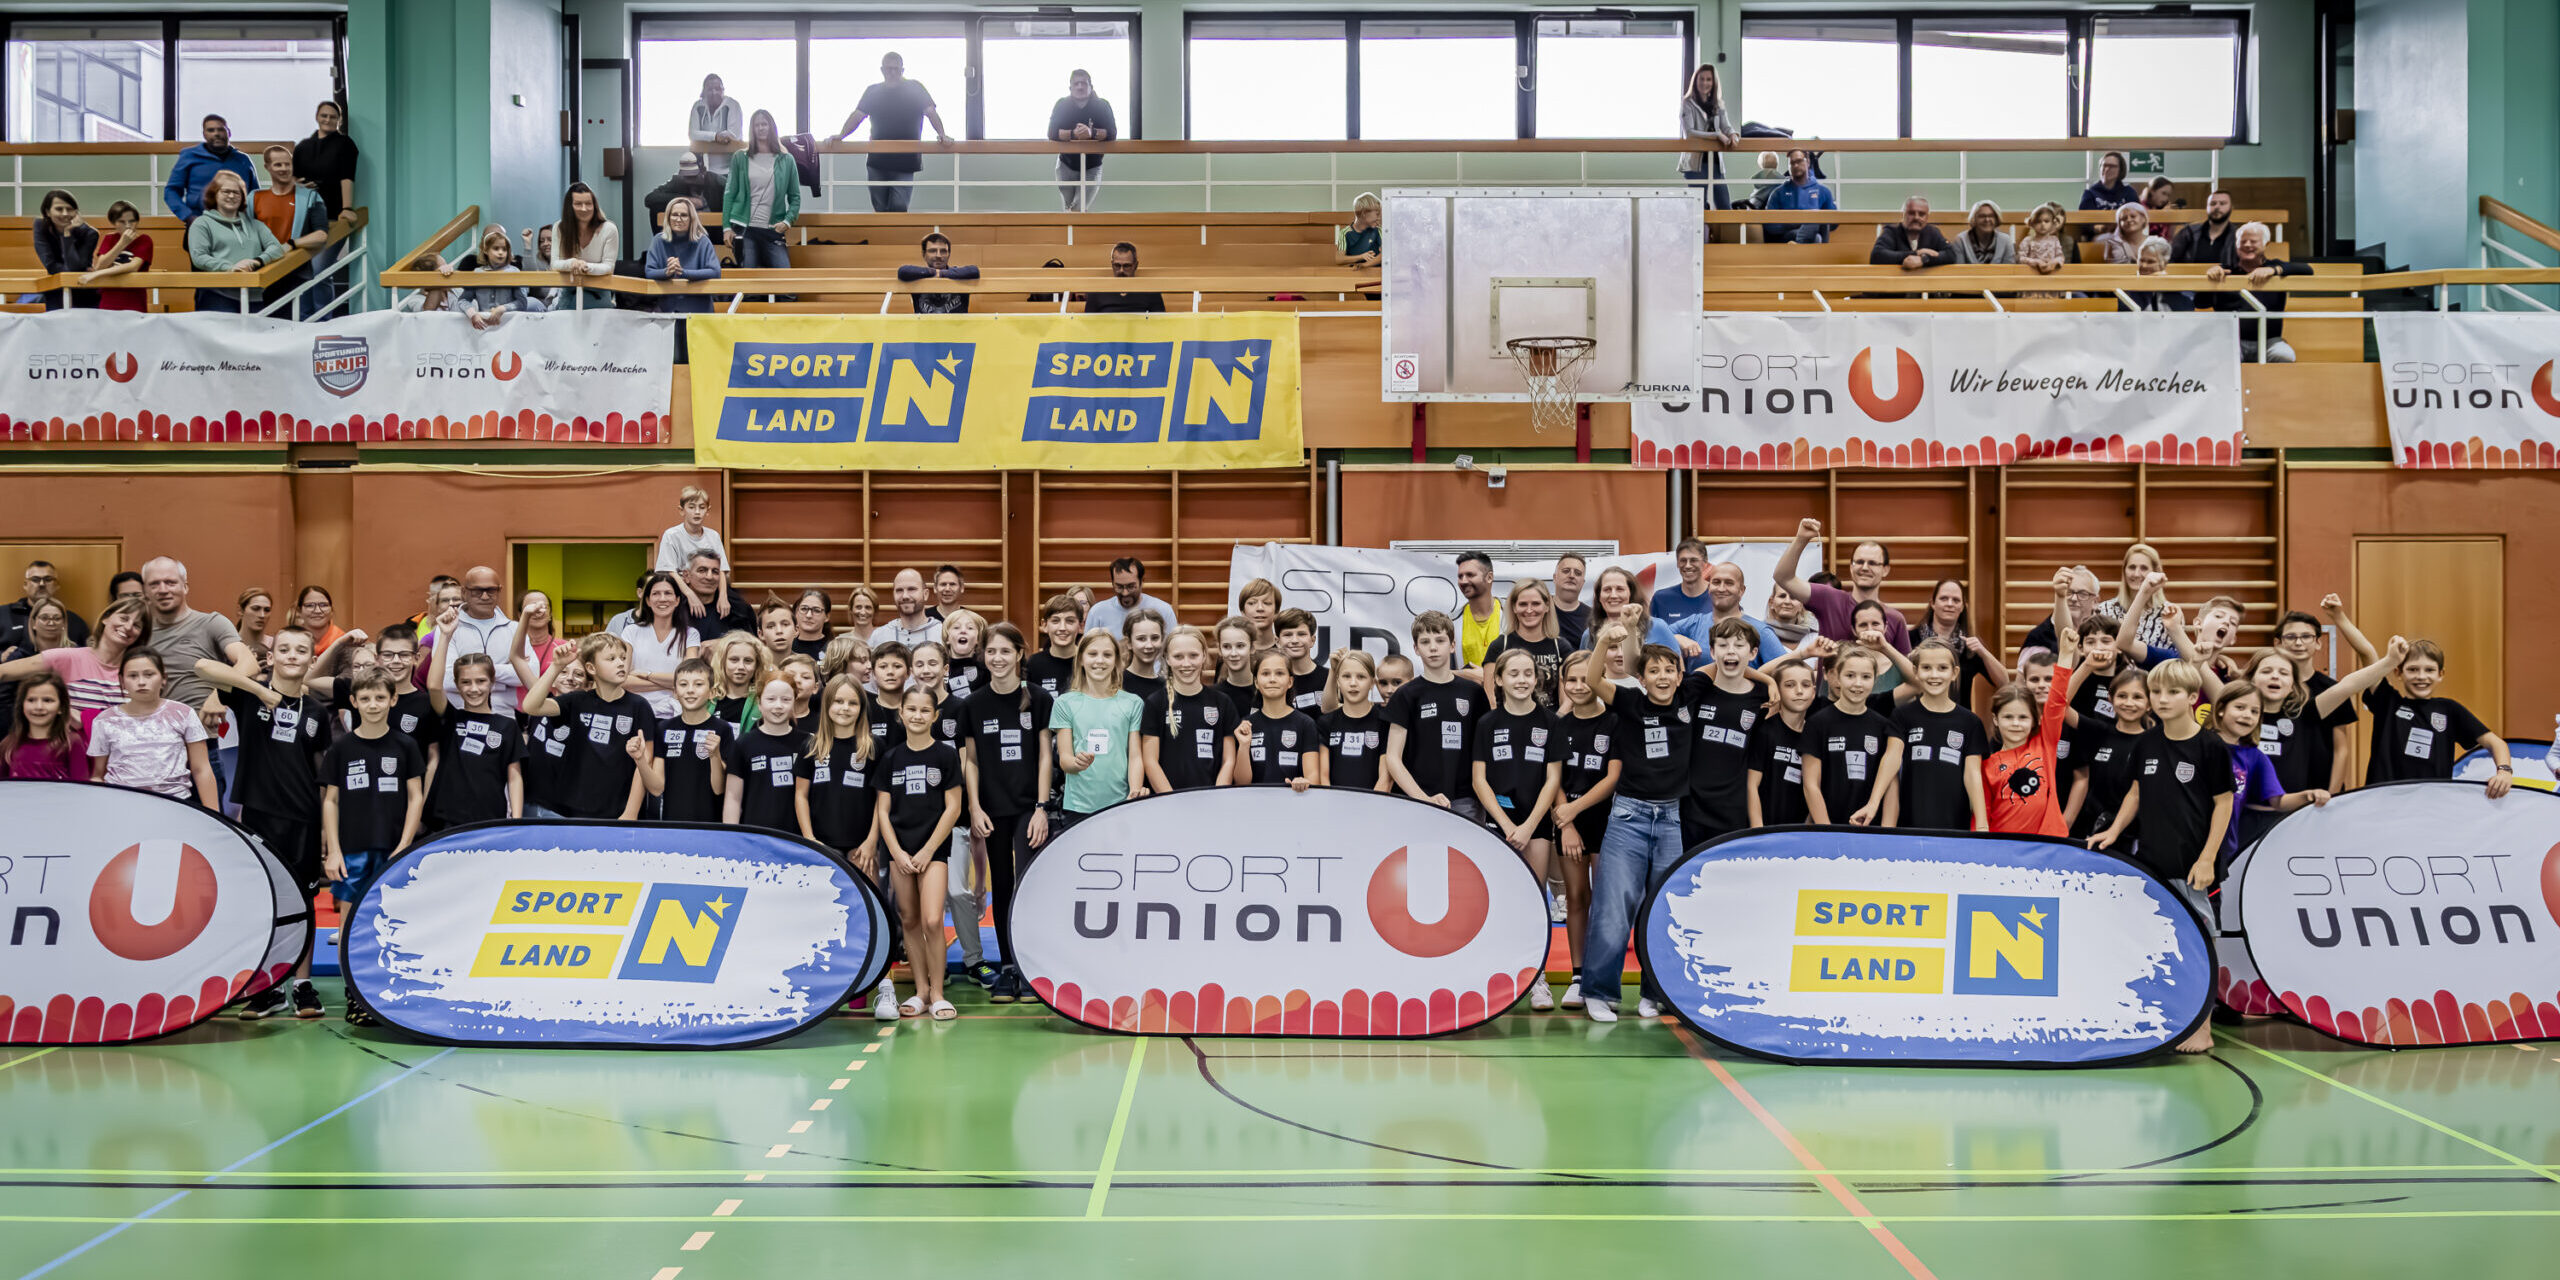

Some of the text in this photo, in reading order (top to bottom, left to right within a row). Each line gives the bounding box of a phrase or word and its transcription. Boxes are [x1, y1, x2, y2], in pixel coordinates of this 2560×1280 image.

[28, 353, 99, 366] SPORT
[313, 346, 367, 360] SPORTUNION
[416, 352, 487, 366] SPORT
[160, 360, 262, 375] Wir bewegen Menschen
[544, 360, 648, 375] Wir bewegen Menschen
[746, 354, 856, 377] SPORT
[1049, 353, 1157, 377] SPORT
[1702, 353, 1830, 381] PORT
[28, 367, 100, 380] union
[416, 366, 486, 379] union
[2392, 361, 2521, 384] SPORT
[1634, 384, 1691, 392] TURKNA
[1949, 368, 2207, 400] Wir bewegen Menschen
[2393, 388, 2523, 409] union
[746, 408, 836, 431] LAND
[1050, 407, 1138, 431] LAND
[2101, 703, 2112, 713] 24
[281, 712, 293, 720] 60
[471, 724, 483, 732] 30
[1446, 725, 1457, 733] 40
[1708, 729, 1720, 738] 22
[594, 731, 605, 740] 27
[1349, 736, 1360, 744] 31
[1651, 731, 1661, 739] 17
[1006, 749, 1016, 757] 59
[1496, 749, 1507, 757] 35
[1916, 748, 1922, 756] 6
[2415, 745, 2421, 754] 5
[1586, 758, 1597, 766] 55
[1853, 754, 1859, 762] 7
[352, 777, 364, 785] 14
[816, 771, 825, 779] 23
[910, 783, 921, 791] 16
[1076, 853, 1343, 893] SPORT
[2287, 855, 2511, 895] SPORT
[511, 891, 623, 914] SPORT
[1814, 901, 1930, 926] SPORT
[1074, 901, 1342, 943] union
[2297, 904, 2536, 948] union
[500, 944, 592, 967] LAND
[1819, 957, 1916, 981] LAND
